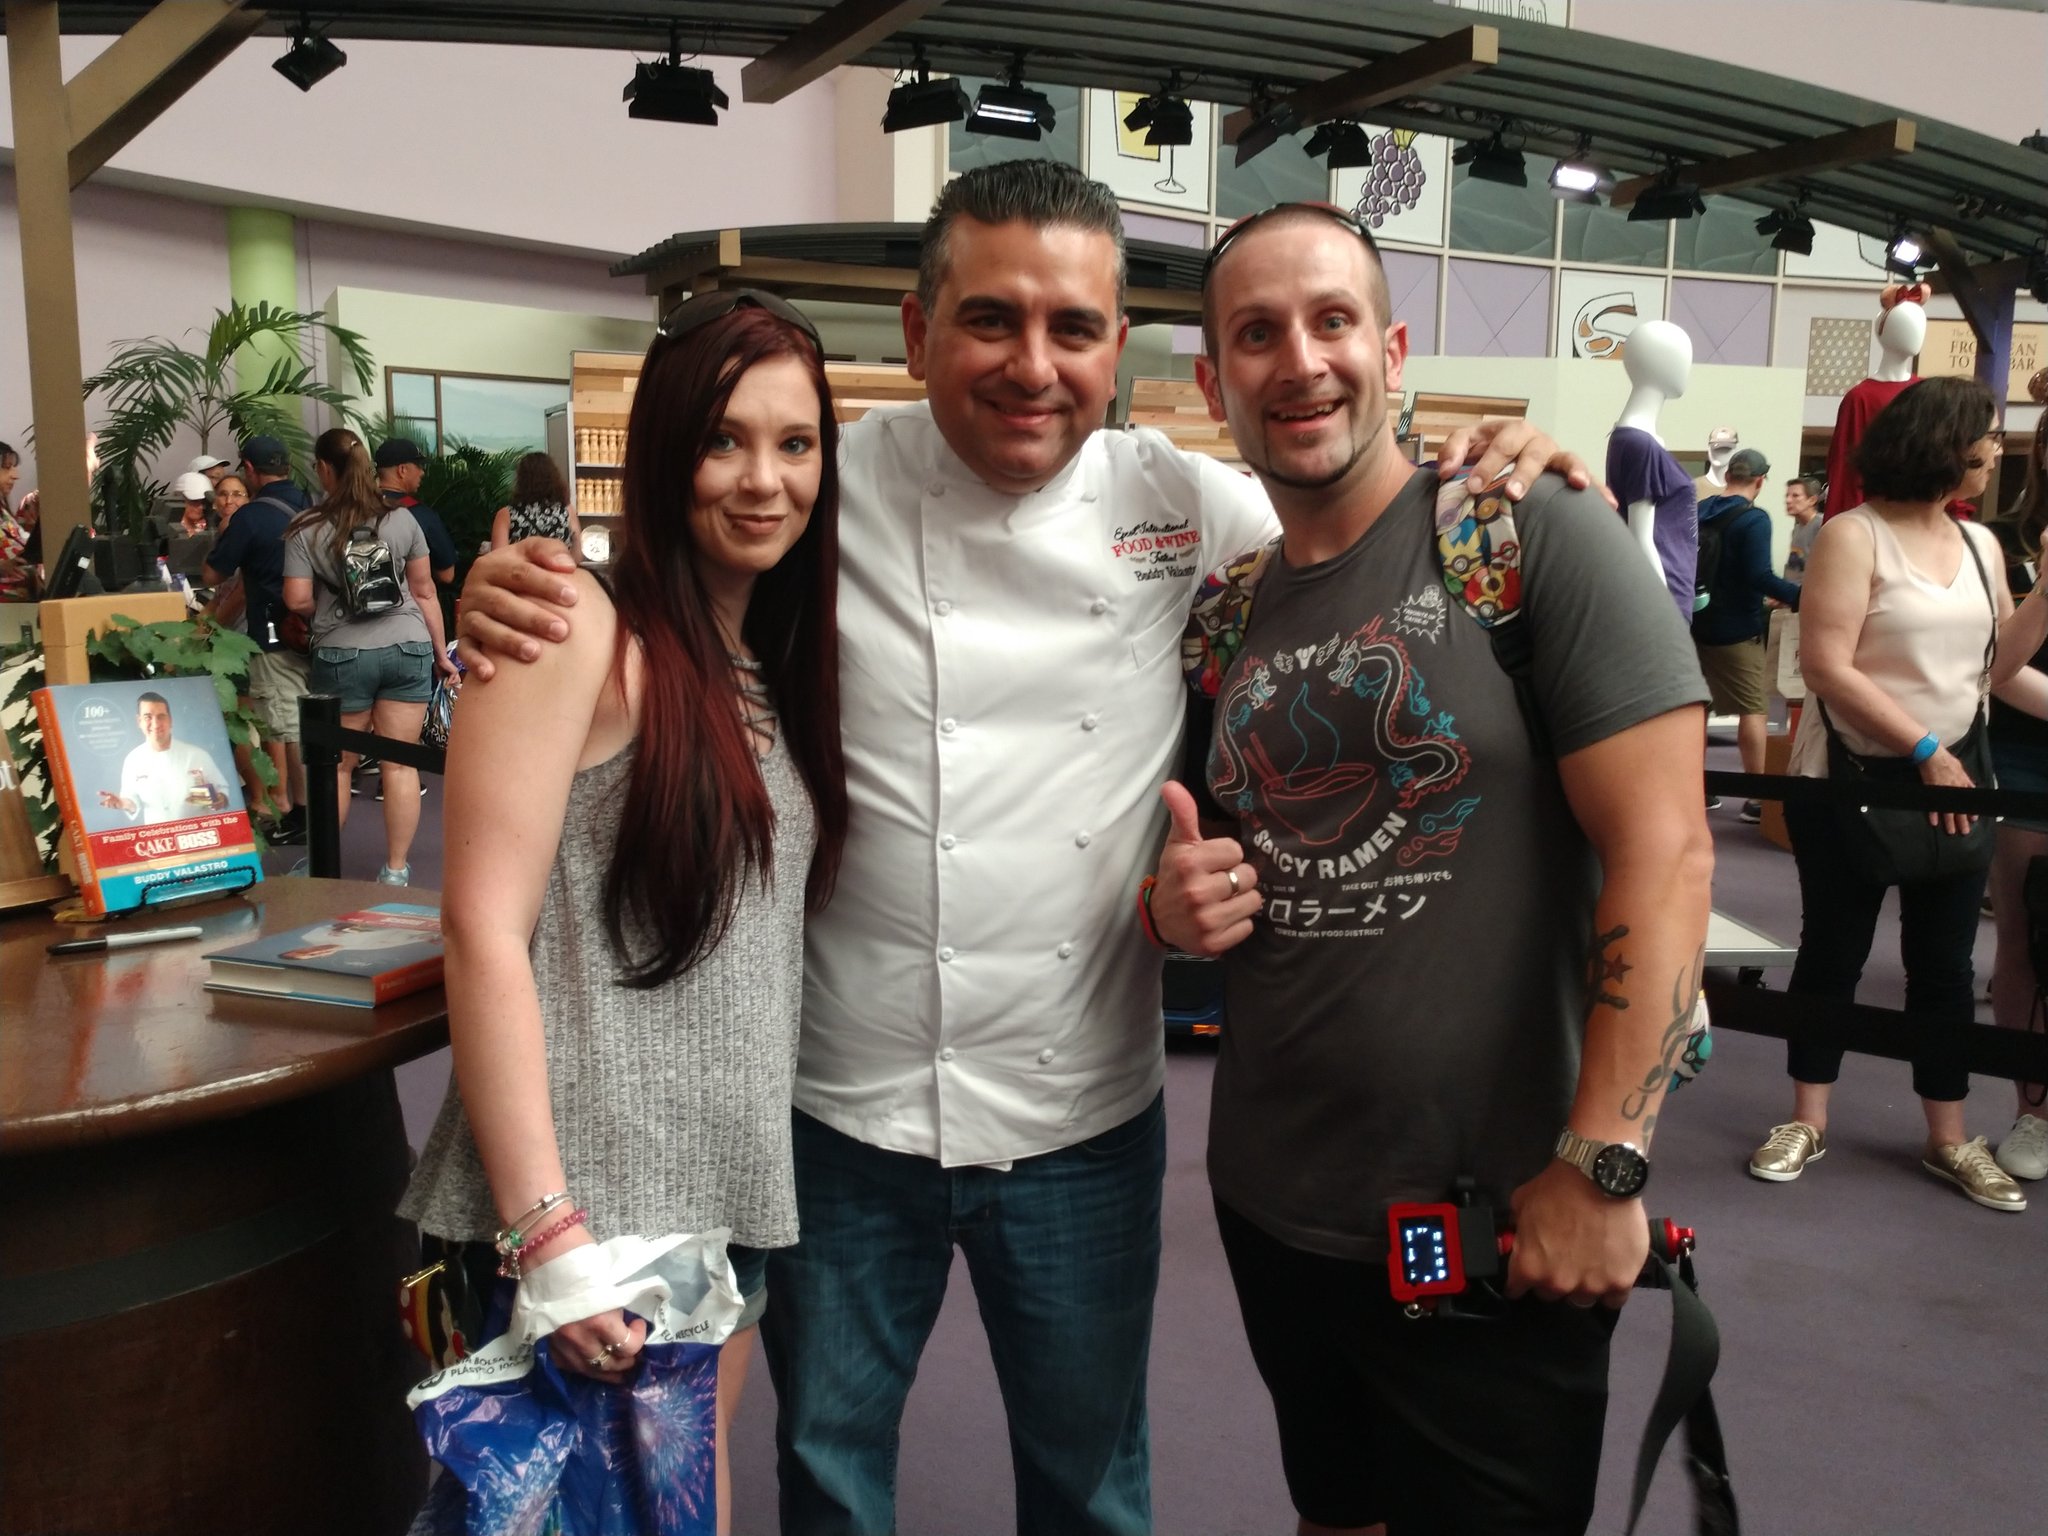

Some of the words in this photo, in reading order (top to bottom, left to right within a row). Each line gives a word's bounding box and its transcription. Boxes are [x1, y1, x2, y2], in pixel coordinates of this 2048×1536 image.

[1949, 355, 1970, 368] TO
[1111, 537, 1153, 557] FOOD
[1164, 530, 1201, 547] WINE
[1134, 569, 1164, 581] Buddy
[102, 832, 136, 844] Family
[139, 823, 198, 837] Celebrations
[200, 819, 222, 828] with
[223, 816, 239, 825] the
[134, 837, 176, 858] CAKE
[177, 830, 217, 850] BOSS
[1253, 829, 1311, 878] SPICY
[1317, 811, 1408, 879] RAMEN
[134, 870, 170, 885] BUDDY
[172, 860, 228, 877] VALASTRO
[1341, 883, 1360, 891] TAKE
[1361, 881, 1379, 890] OUT
[1345, 928, 1384, 937] DISTRICT
[675, 1320, 710, 1340] RECYCLE
